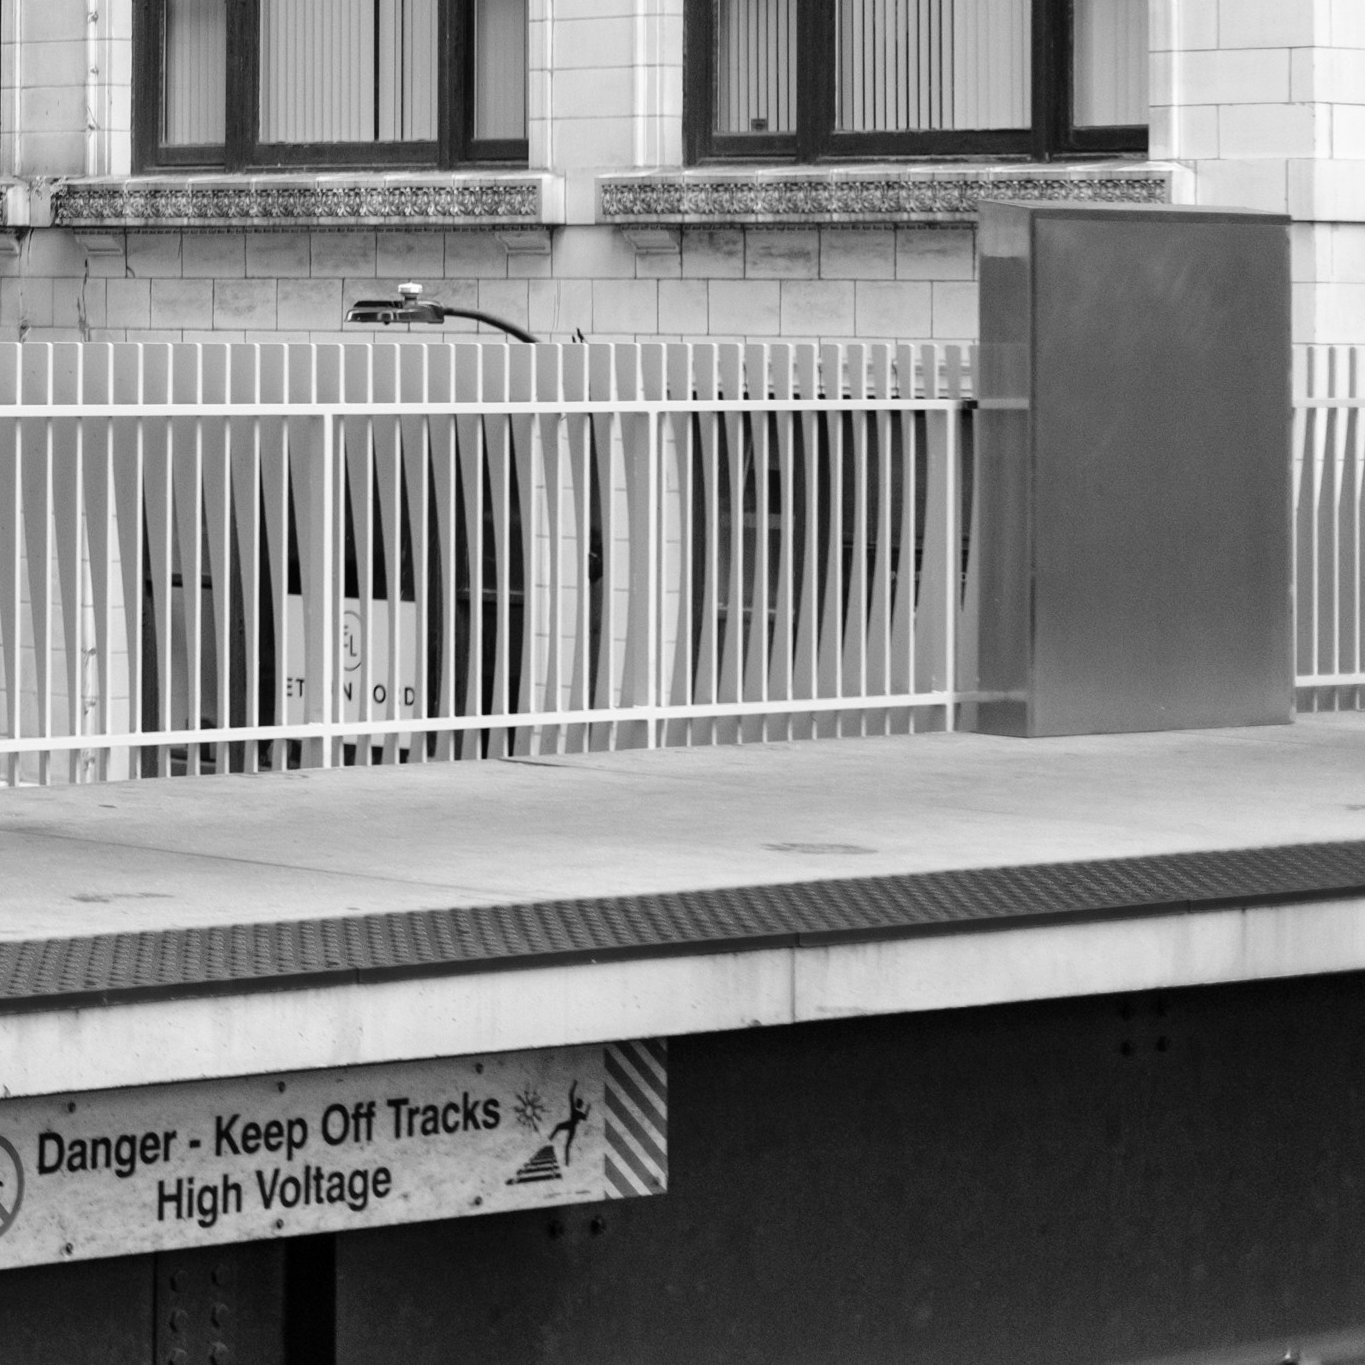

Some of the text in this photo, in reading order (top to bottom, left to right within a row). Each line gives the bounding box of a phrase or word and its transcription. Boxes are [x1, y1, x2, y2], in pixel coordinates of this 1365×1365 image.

[36, 1128, 178, 1179] Danger
[214, 1113, 309, 1162] Keep
[320, 1099, 376, 1147] Off
[385, 1090, 502, 1140] Tracks
[157, 1164, 392, 1229] High Voltage
